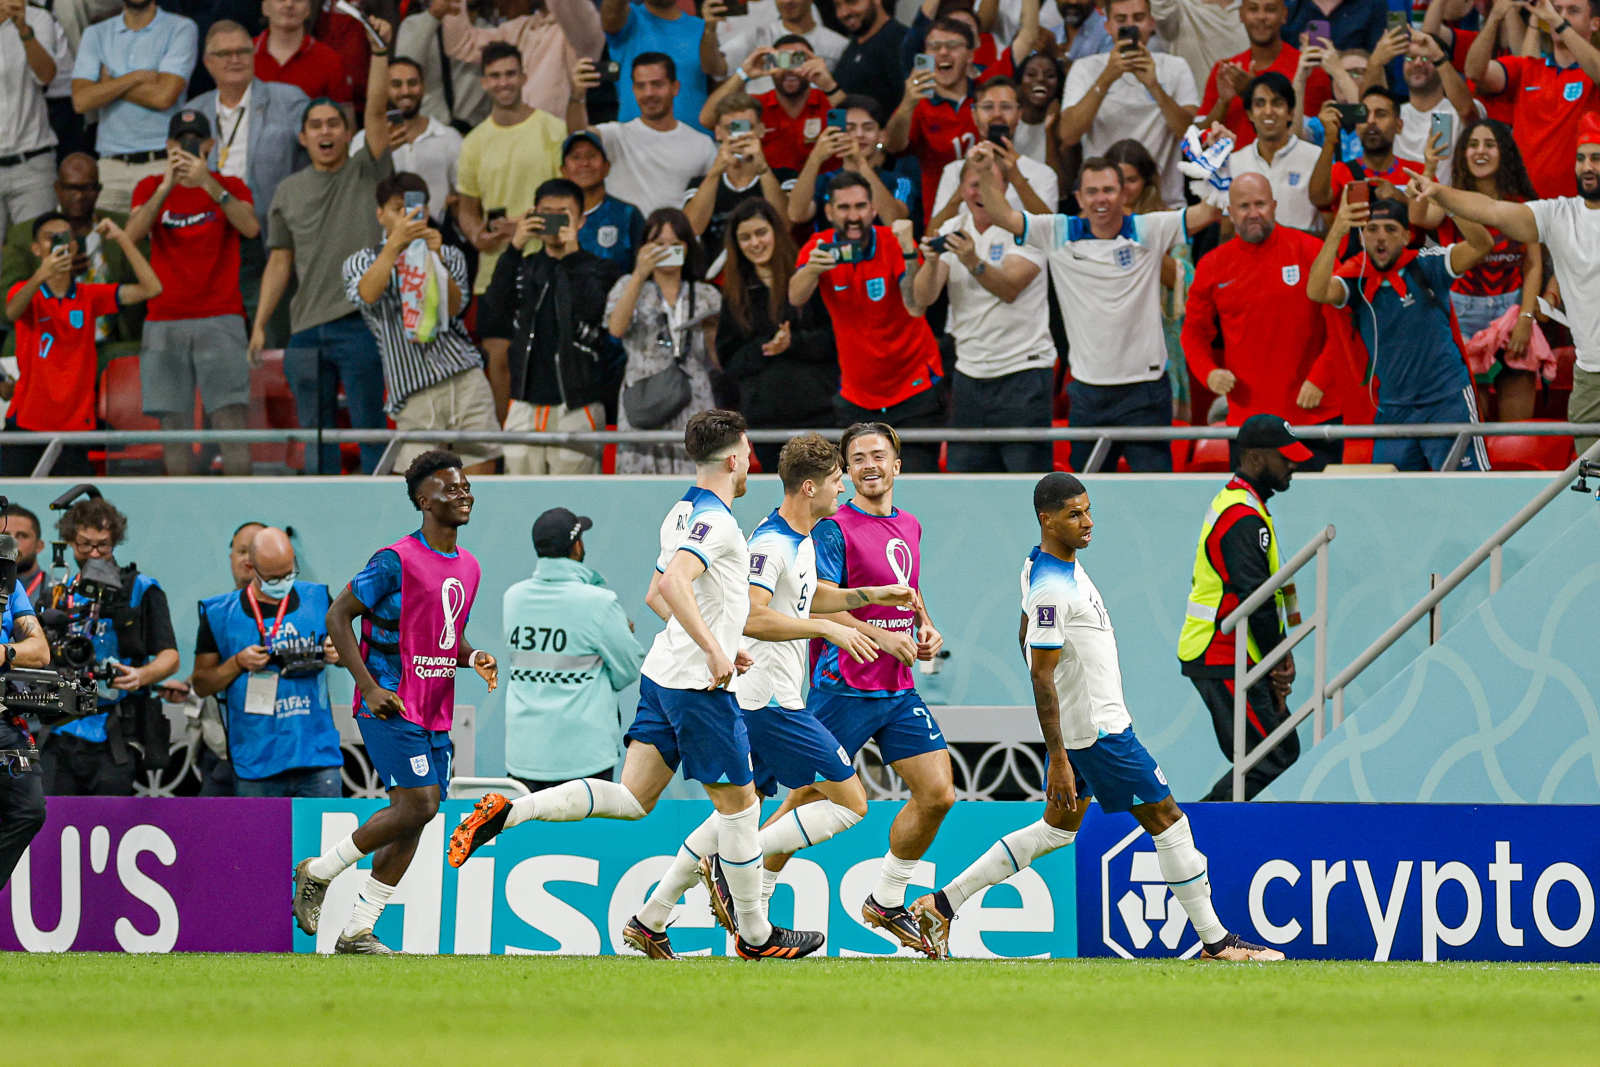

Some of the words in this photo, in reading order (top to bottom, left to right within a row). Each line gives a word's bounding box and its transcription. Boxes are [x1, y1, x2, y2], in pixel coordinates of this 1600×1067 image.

[797, 583, 808, 611] 5
[888, 616, 914, 629] WORD
[510, 625, 567, 653] 4370
[413, 655, 434, 666] FIFA
[912, 706, 933, 729] 7
[315, 811, 1055, 959] Hisense
[1248, 840, 1596, 962] crypto
